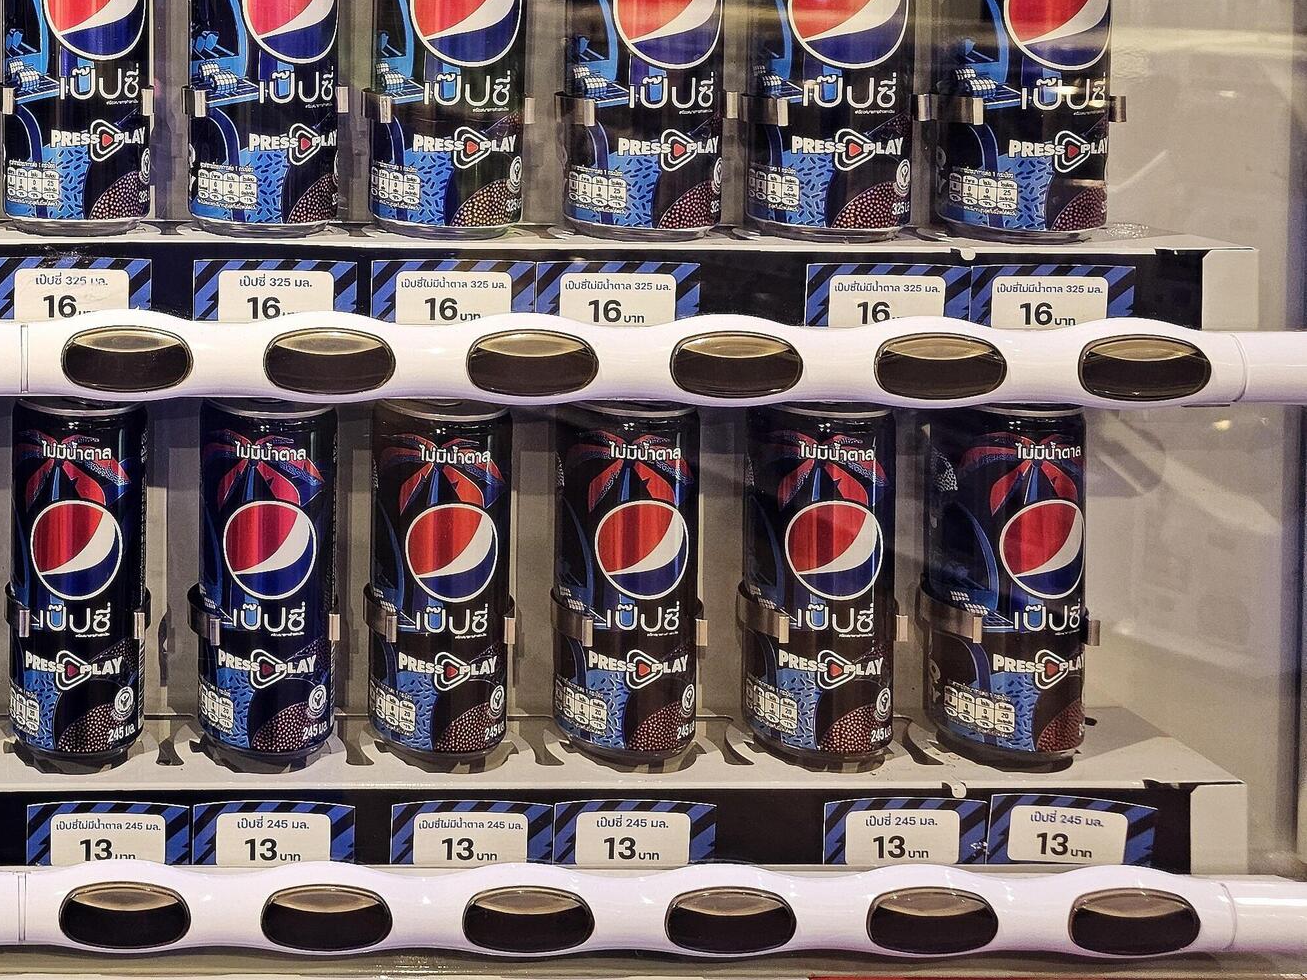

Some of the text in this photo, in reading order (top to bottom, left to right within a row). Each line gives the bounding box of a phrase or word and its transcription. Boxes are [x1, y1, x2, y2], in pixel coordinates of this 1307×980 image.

[59, 67, 139, 101] เป๊ปซี่
[423, 72, 511, 105] เป๊ปซี่
[629, 71, 714, 108] เป๊ปซี่
[413, 134, 516, 153] PRESS PLAY
[792, 136, 903, 155] PRESS PLAY
[471, 280, 489, 289] 325
[635, 282, 653, 291] 325
[1066, 285, 1085, 293] 325
[247, 297, 280, 319] 16
[424, 298, 481, 320] 16 บาท
[588, 299, 645, 324] 16 บาท
[1019, 302, 1076, 326] 16 บาท
[42, 439, 112, 461] ไม่มีน้ำตาล
[235, 439, 307, 463] ไม่มีน้ำตาล
[609, 439, 680, 463] ไม่มีน้ำตาล
[799, 439, 874, 463] ไม่มีน้ำตาล
[39, 602, 111, 633] เป๊ปซี่
[233, 602, 305, 633] เป๊ปซี่
[606, 602, 679, 634] เป๊ปซี่
[26, 651, 123, 675] PRESS PLAY
[219, 649, 316, 674] PRESS PLAY
[588, 650, 688, 673] PRESS PLAY
[267, 820, 289, 829] 245
[487, 821, 505, 829] 245
[626, 818, 647, 827] 245
[895, 816, 915, 825] 245
[1060, 814, 1082, 824] 245
[244, 838, 301, 862] 13 บาท
[442, 838, 497, 862] 13 บาท
[603, 837, 659, 861] 13 บาท
[872, 835, 928, 858] 13 บาท
[1036, 832, 1092, 858] 13 บาท
